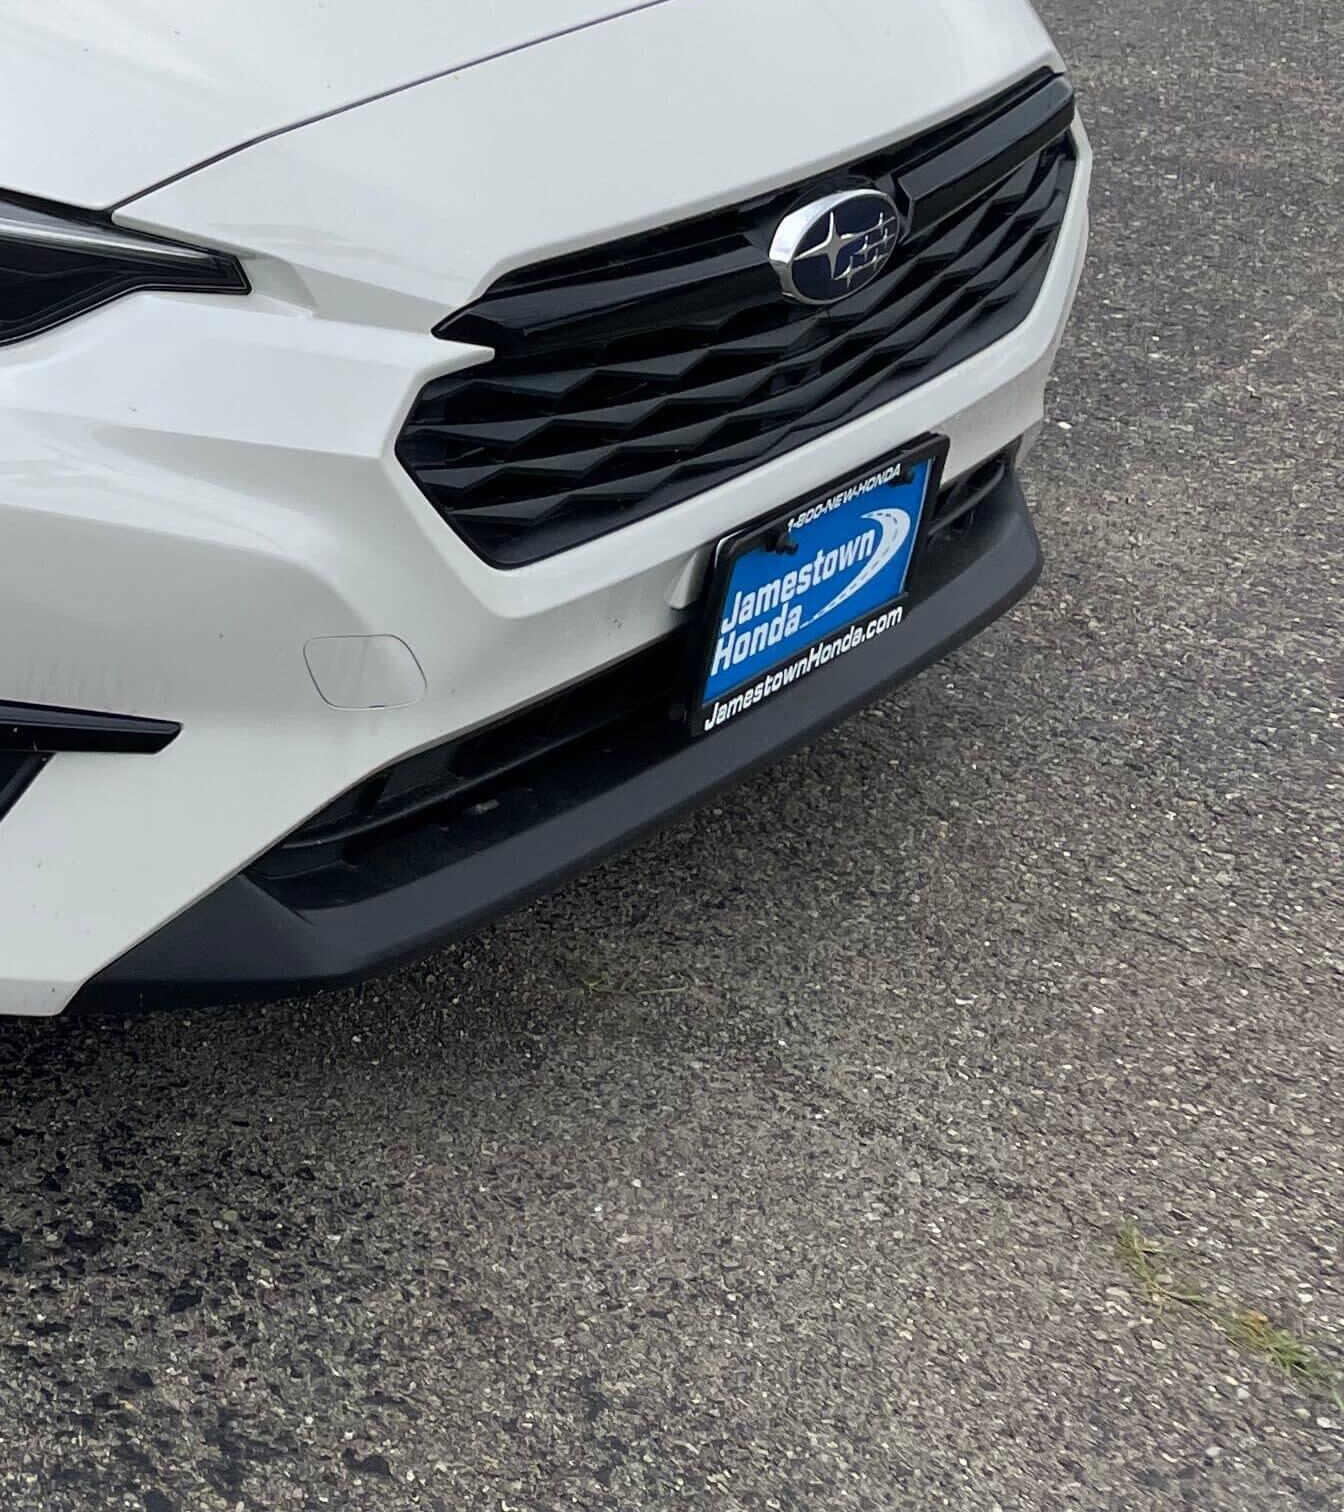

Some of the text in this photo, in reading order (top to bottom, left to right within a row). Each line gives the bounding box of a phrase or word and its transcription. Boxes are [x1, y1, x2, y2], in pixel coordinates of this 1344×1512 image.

[720, 528, 876, 634] Jamestown
[704, 606, 904, 731] JamestownHonda.com
[710, 603, 803, 677] Honda
